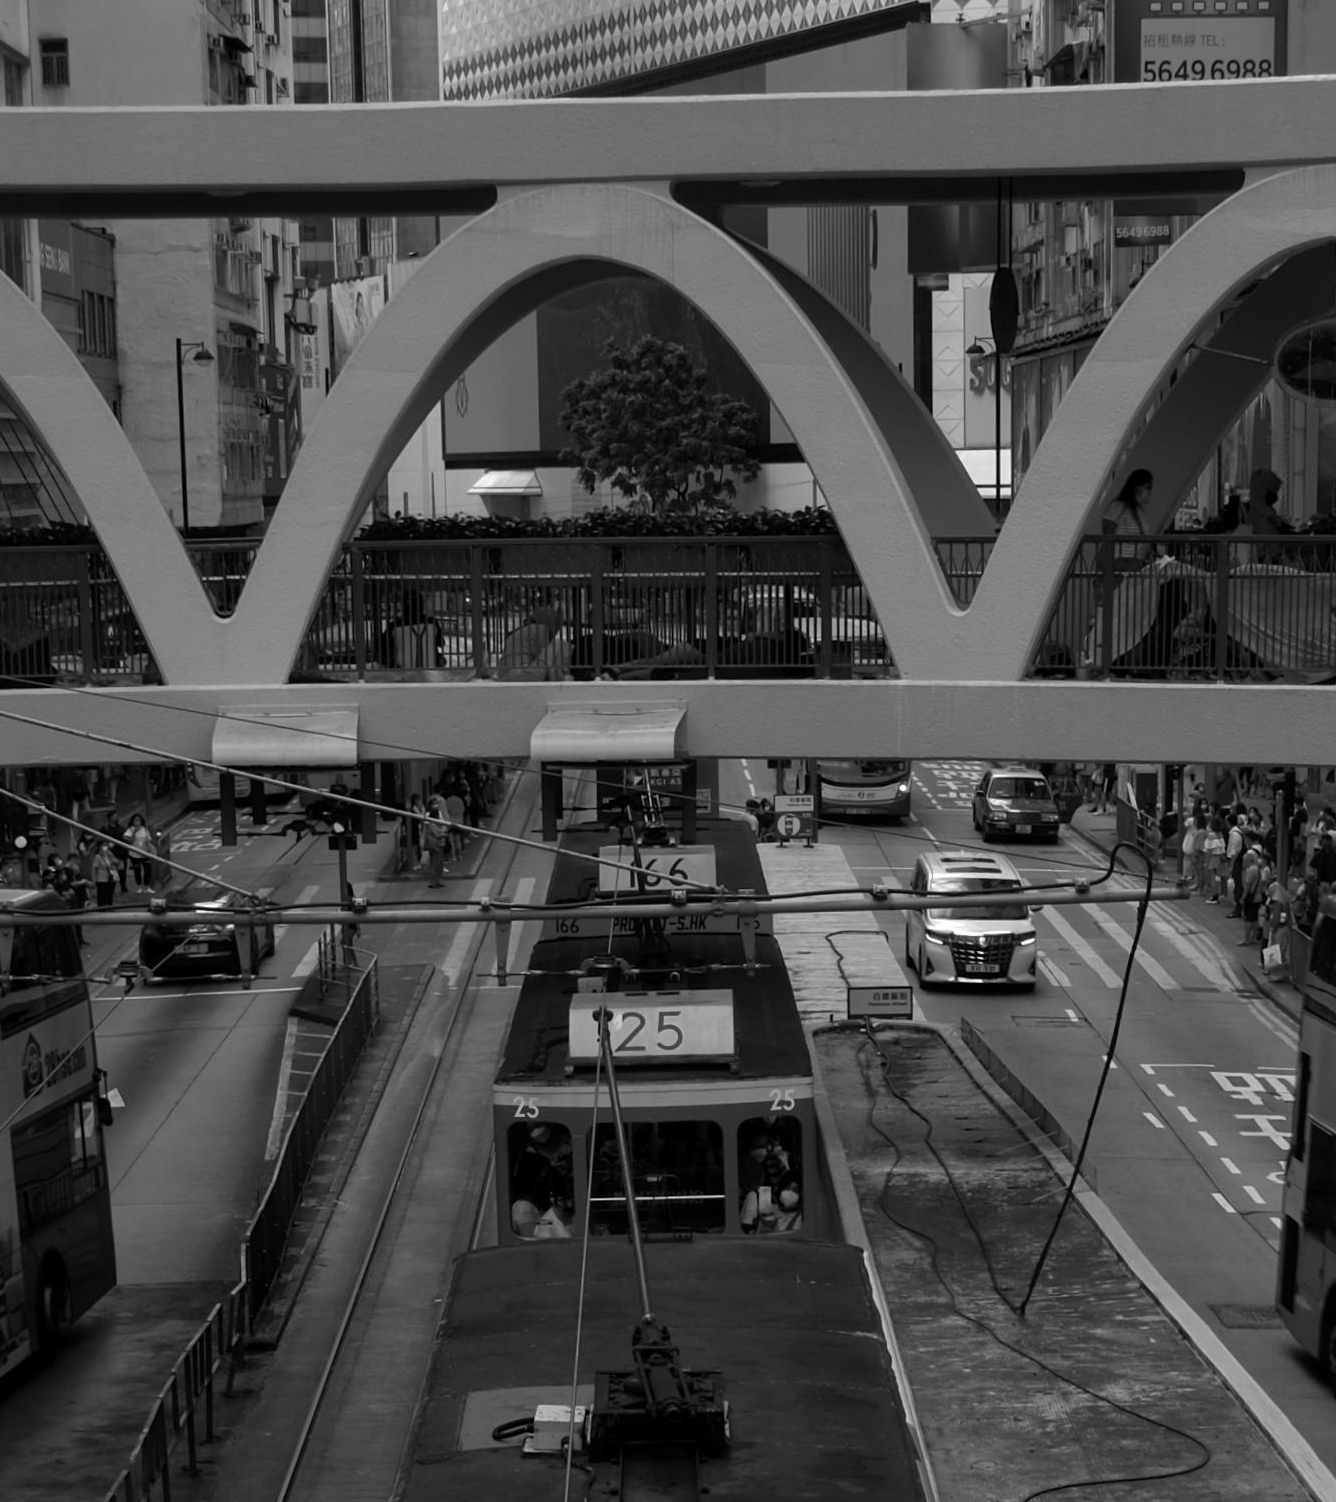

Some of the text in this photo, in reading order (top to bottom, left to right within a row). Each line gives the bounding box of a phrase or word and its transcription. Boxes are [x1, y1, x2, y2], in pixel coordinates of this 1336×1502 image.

[1143, 58, 1272, 82] 5649 6988
[628, 858, 688, 889] 166
[555, 918, 579, 934] 166
[616, 1011, 683, 1052] 25
[513, 1097, 540, 1119] 25
[769, 1089, 796, 1112] 25
